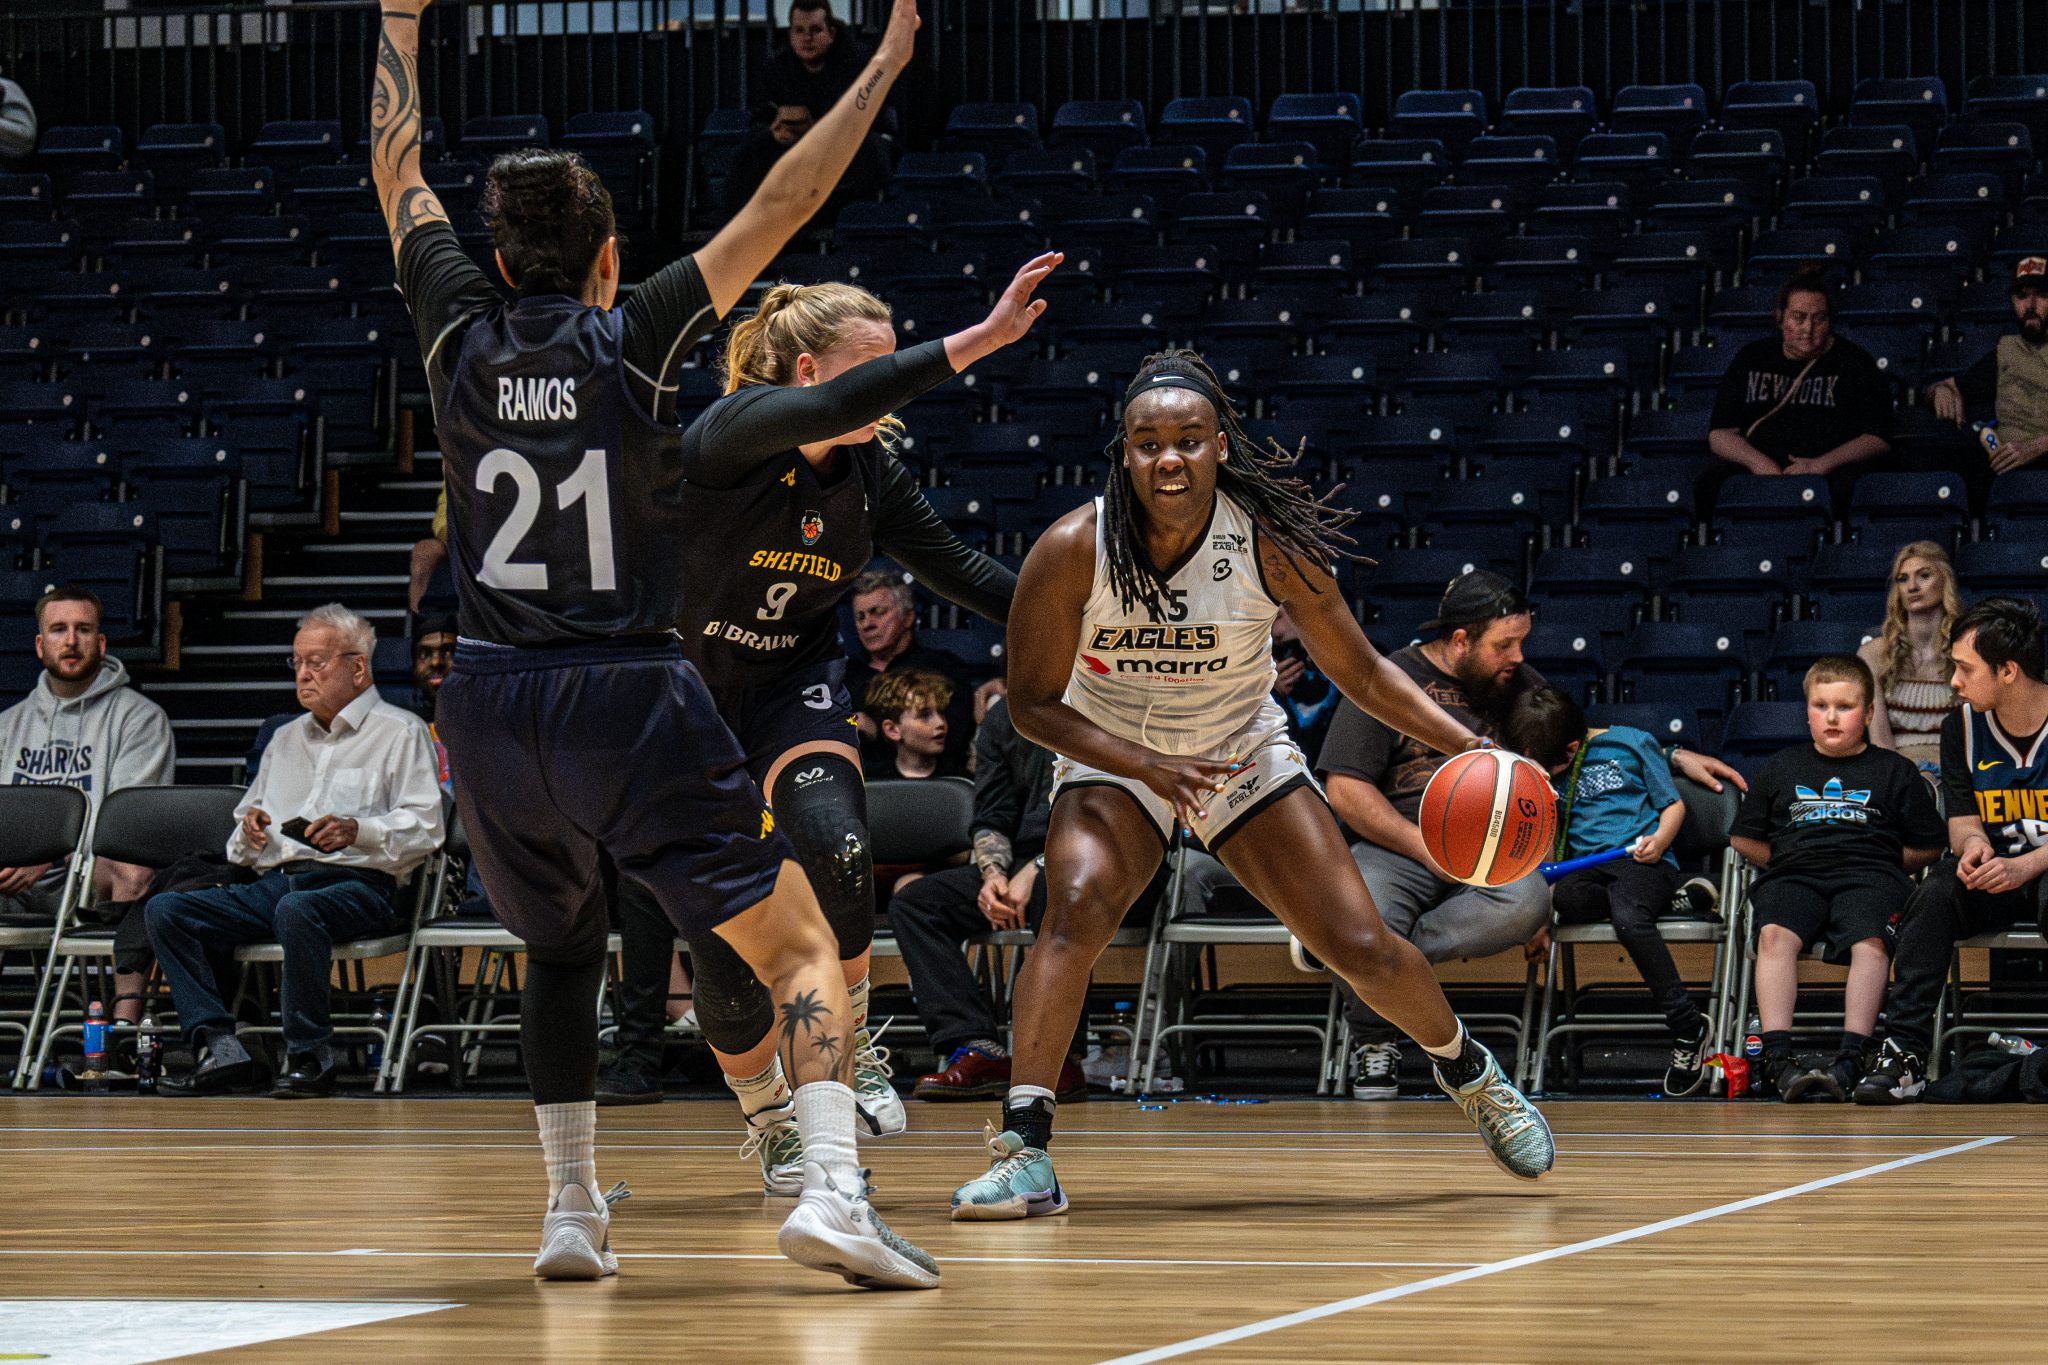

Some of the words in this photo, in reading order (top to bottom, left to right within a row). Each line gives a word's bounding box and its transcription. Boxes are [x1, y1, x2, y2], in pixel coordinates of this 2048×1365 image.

[498, 377, 578, 421] RAMOS
[1745, 370, 1790, 403] NEW
[475, 449, 617, 591] 21
[1212, 543, 1248, 554] EAGLES
[749, 549, 842, 582] SHEFFIELD
[757, 582, 798, 621] 9
[1090, 625, 1218, 652] EAGLES
[1116, 656, 1229, 675] marra
[16, 745, 92, 775] SHARKS
